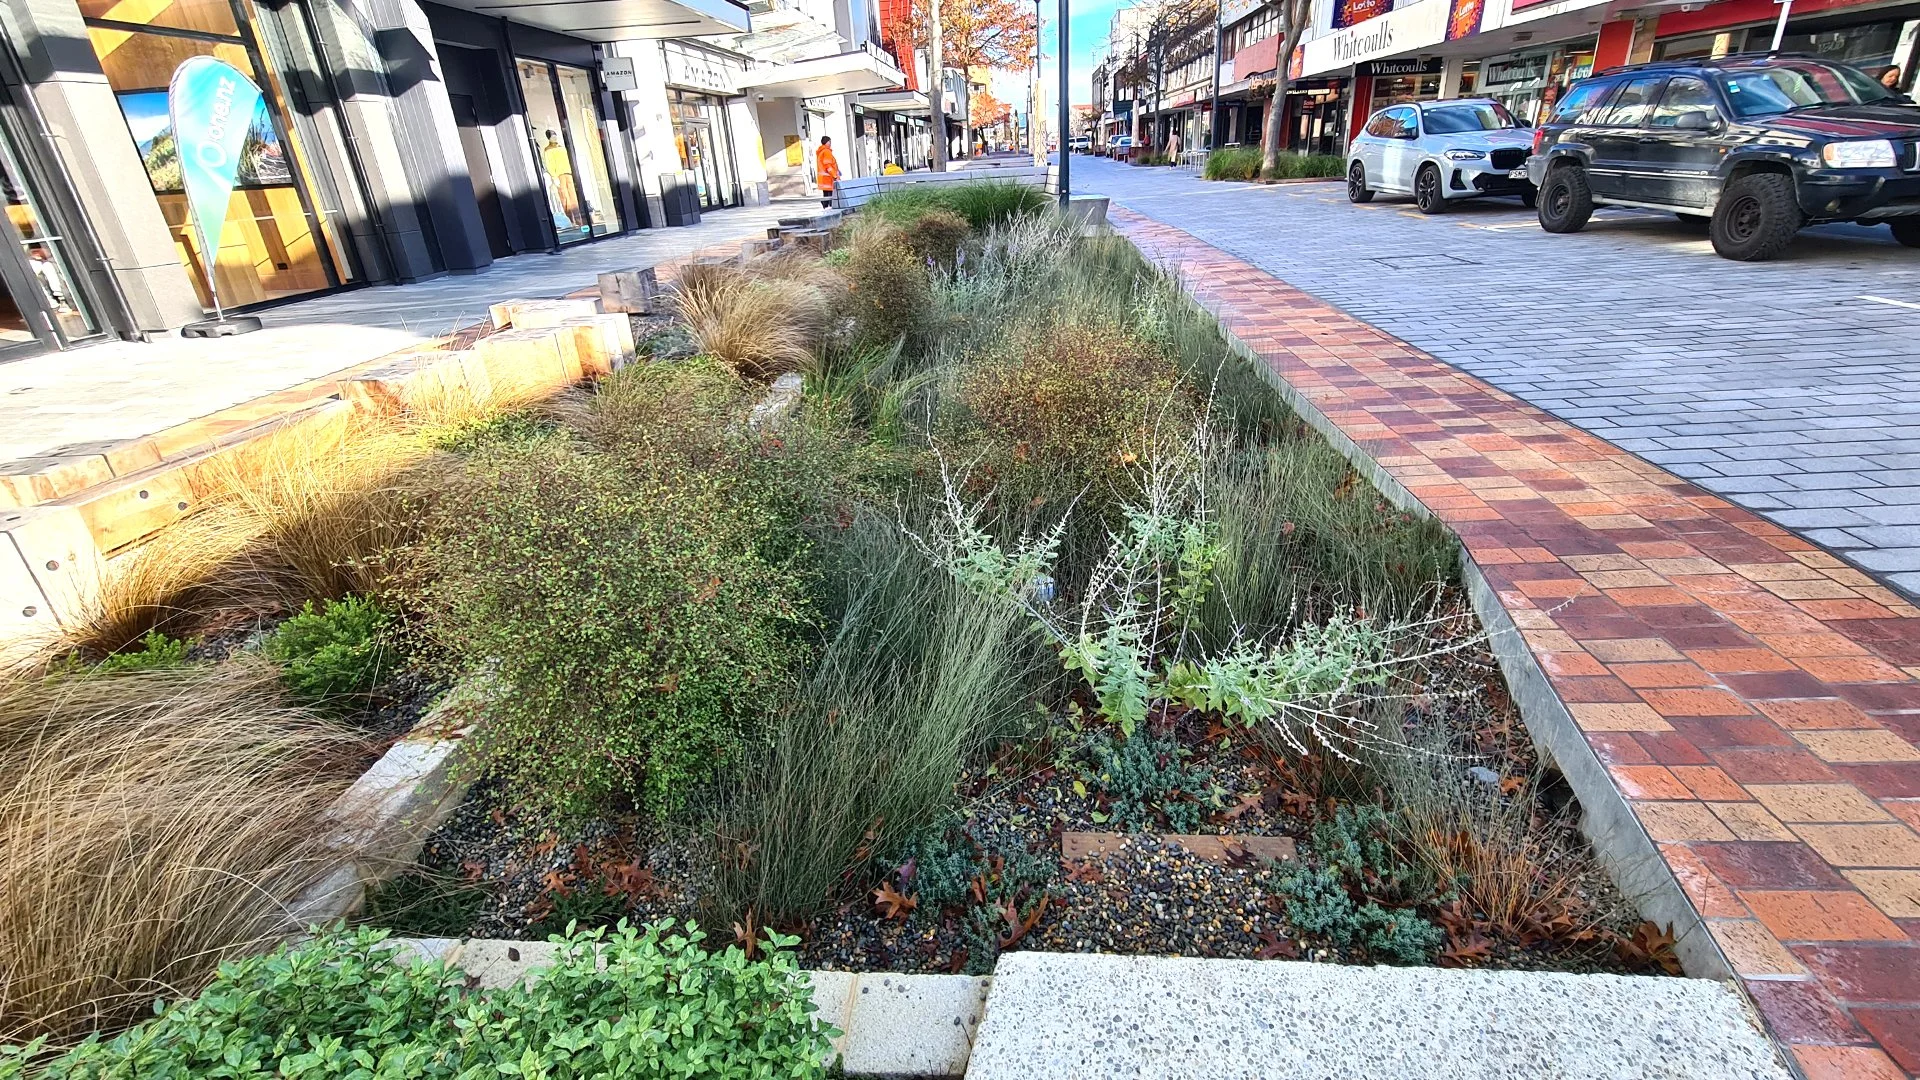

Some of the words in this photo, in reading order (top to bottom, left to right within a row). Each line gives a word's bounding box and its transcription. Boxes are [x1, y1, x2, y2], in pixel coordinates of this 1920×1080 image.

[1352, 0, 1376, 11] Lotto
[1459, 1, 1475, 16] Lotto
[1333, 20, 1394, 61] Whitcoulls
[1371, 62, 1428, 74] Whitcoulls
